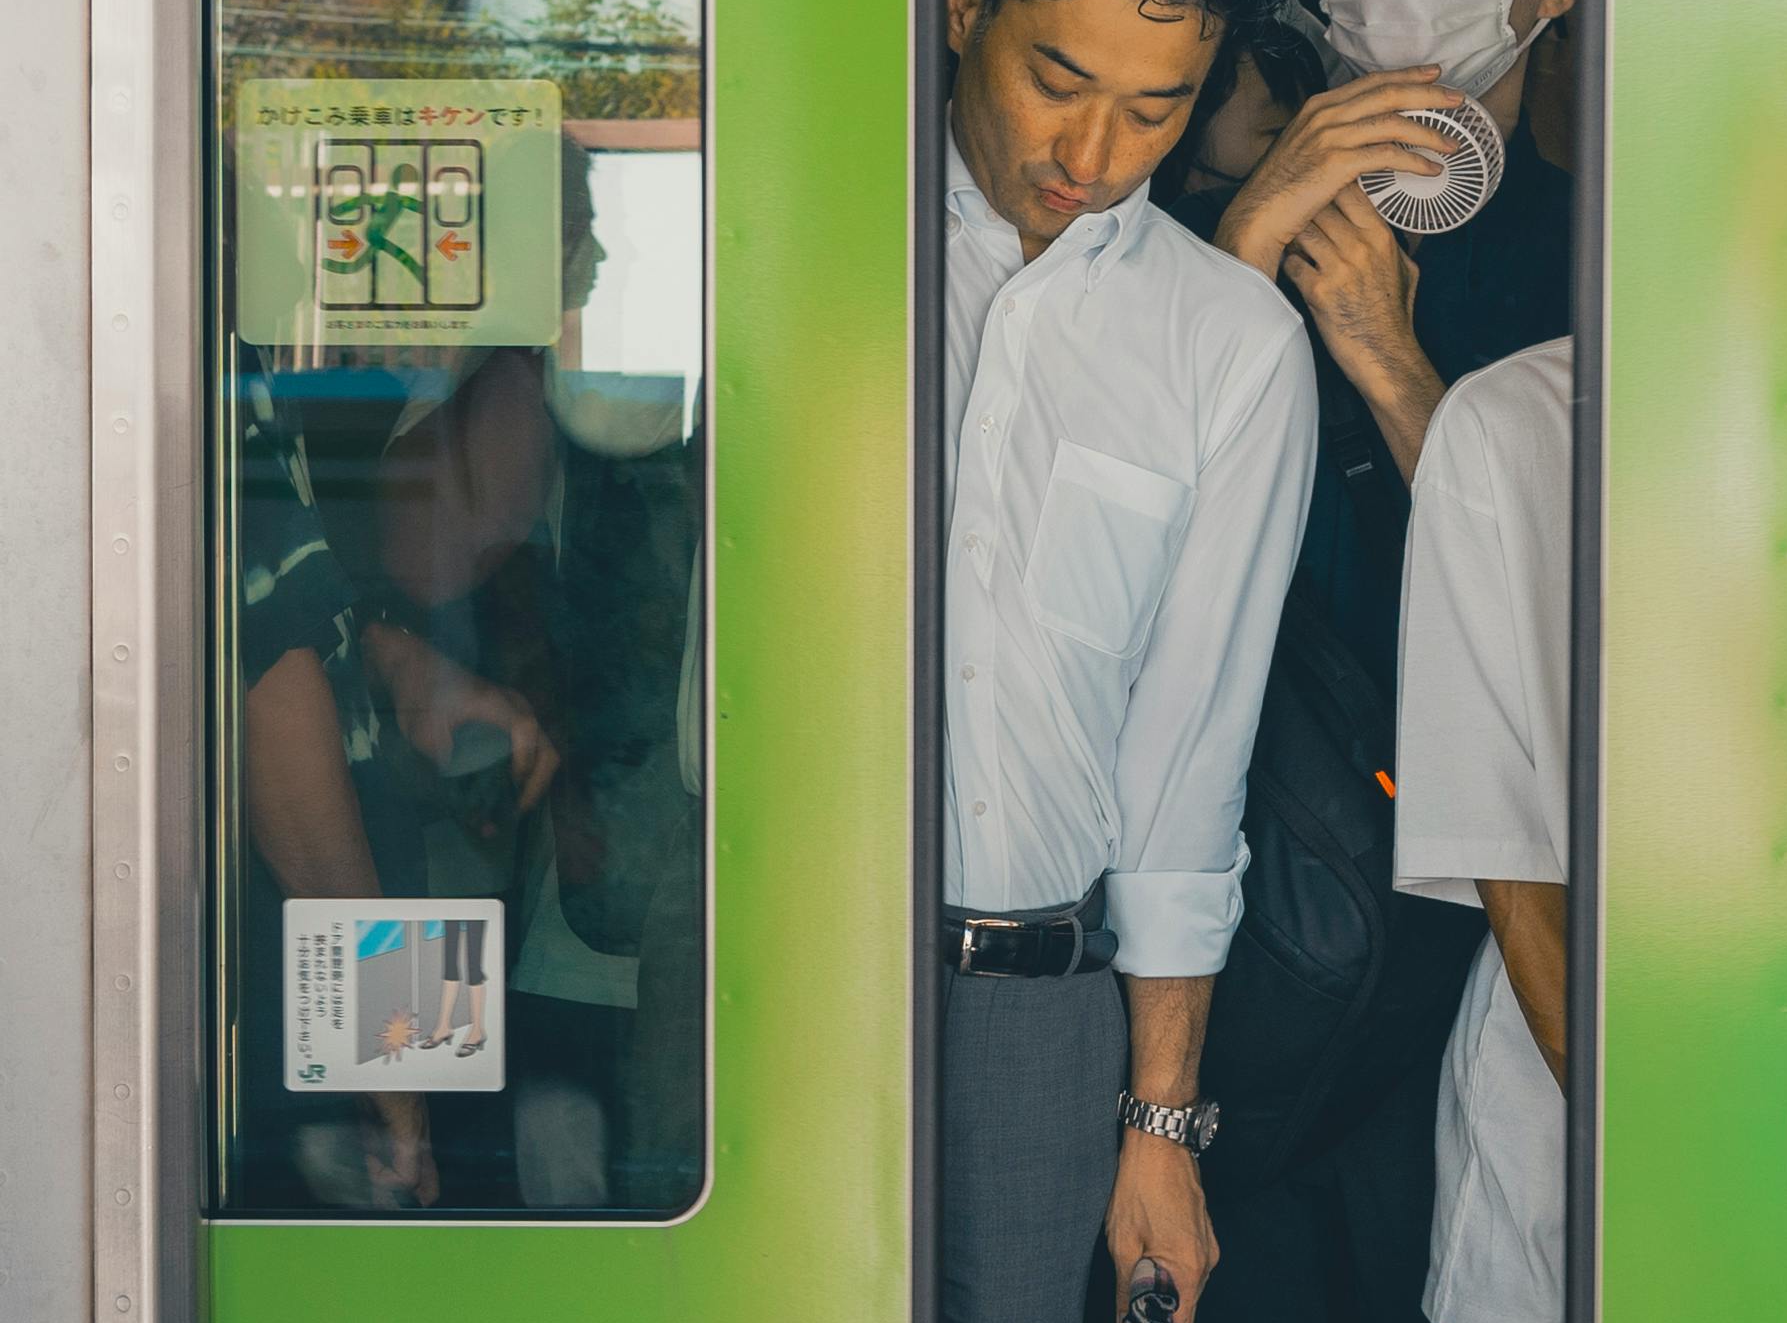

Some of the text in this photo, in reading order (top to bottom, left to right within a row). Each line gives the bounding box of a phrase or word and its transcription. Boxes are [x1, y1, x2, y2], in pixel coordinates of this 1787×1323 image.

[256, 105, 544, 127] かけこみ乗車はキケンです！
[297, 1063, 327, 1079] JR
